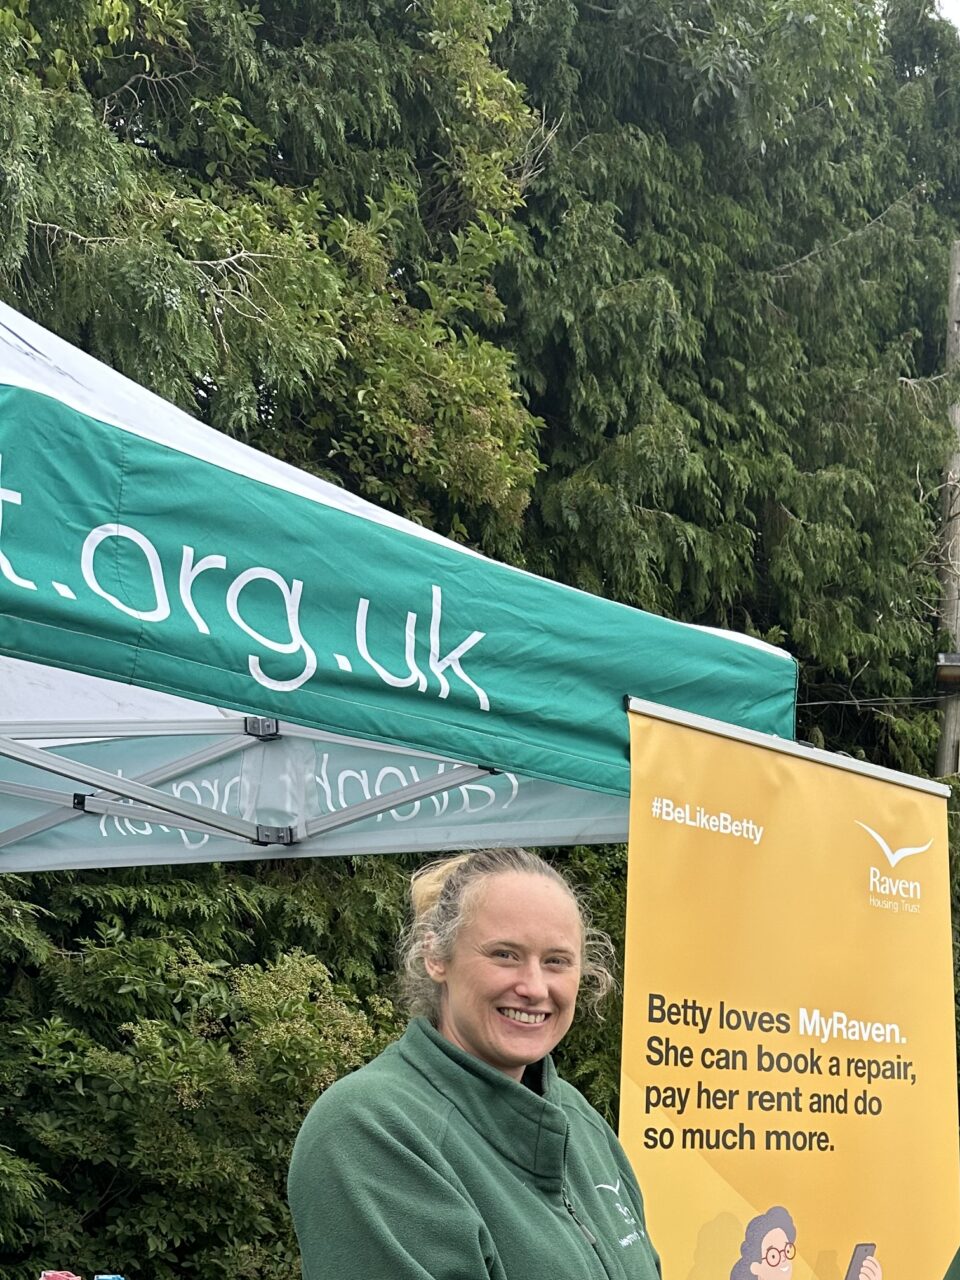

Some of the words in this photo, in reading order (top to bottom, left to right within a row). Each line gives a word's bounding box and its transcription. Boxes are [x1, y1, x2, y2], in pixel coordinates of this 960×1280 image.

[651, 796, 764, 845] #BeLikeBetty
[869, 866, 921, 899] Raven
[869, 895, 899, 913] Housing
[901, 900, 920, 913] Trust
[648, 993, 712, 1034] Betty
[719, 1001, 791, 1033] loves
[798, 1007, 907, 1044] MyRaven.
[646, 1036, 694, 1067] She
[701, 1047, 747, 1071] can
[757, 1044, 823, 1075] book
[828, 1056, 840, 1076] a
[846, 1054, 917, 1085] repair,
[645, 1084, 690, 1115] pay
[697, 1081, 739, 1110] her
[747, 1087, 802, 1112] rent
[809, 1088, 848, 1114] and
[854, 1089, 882, 1116] do
[643, 1126, 674, 1150] so
[682, 1122, 755, 1150] much
[765, 1128, 835, 1151] more.
